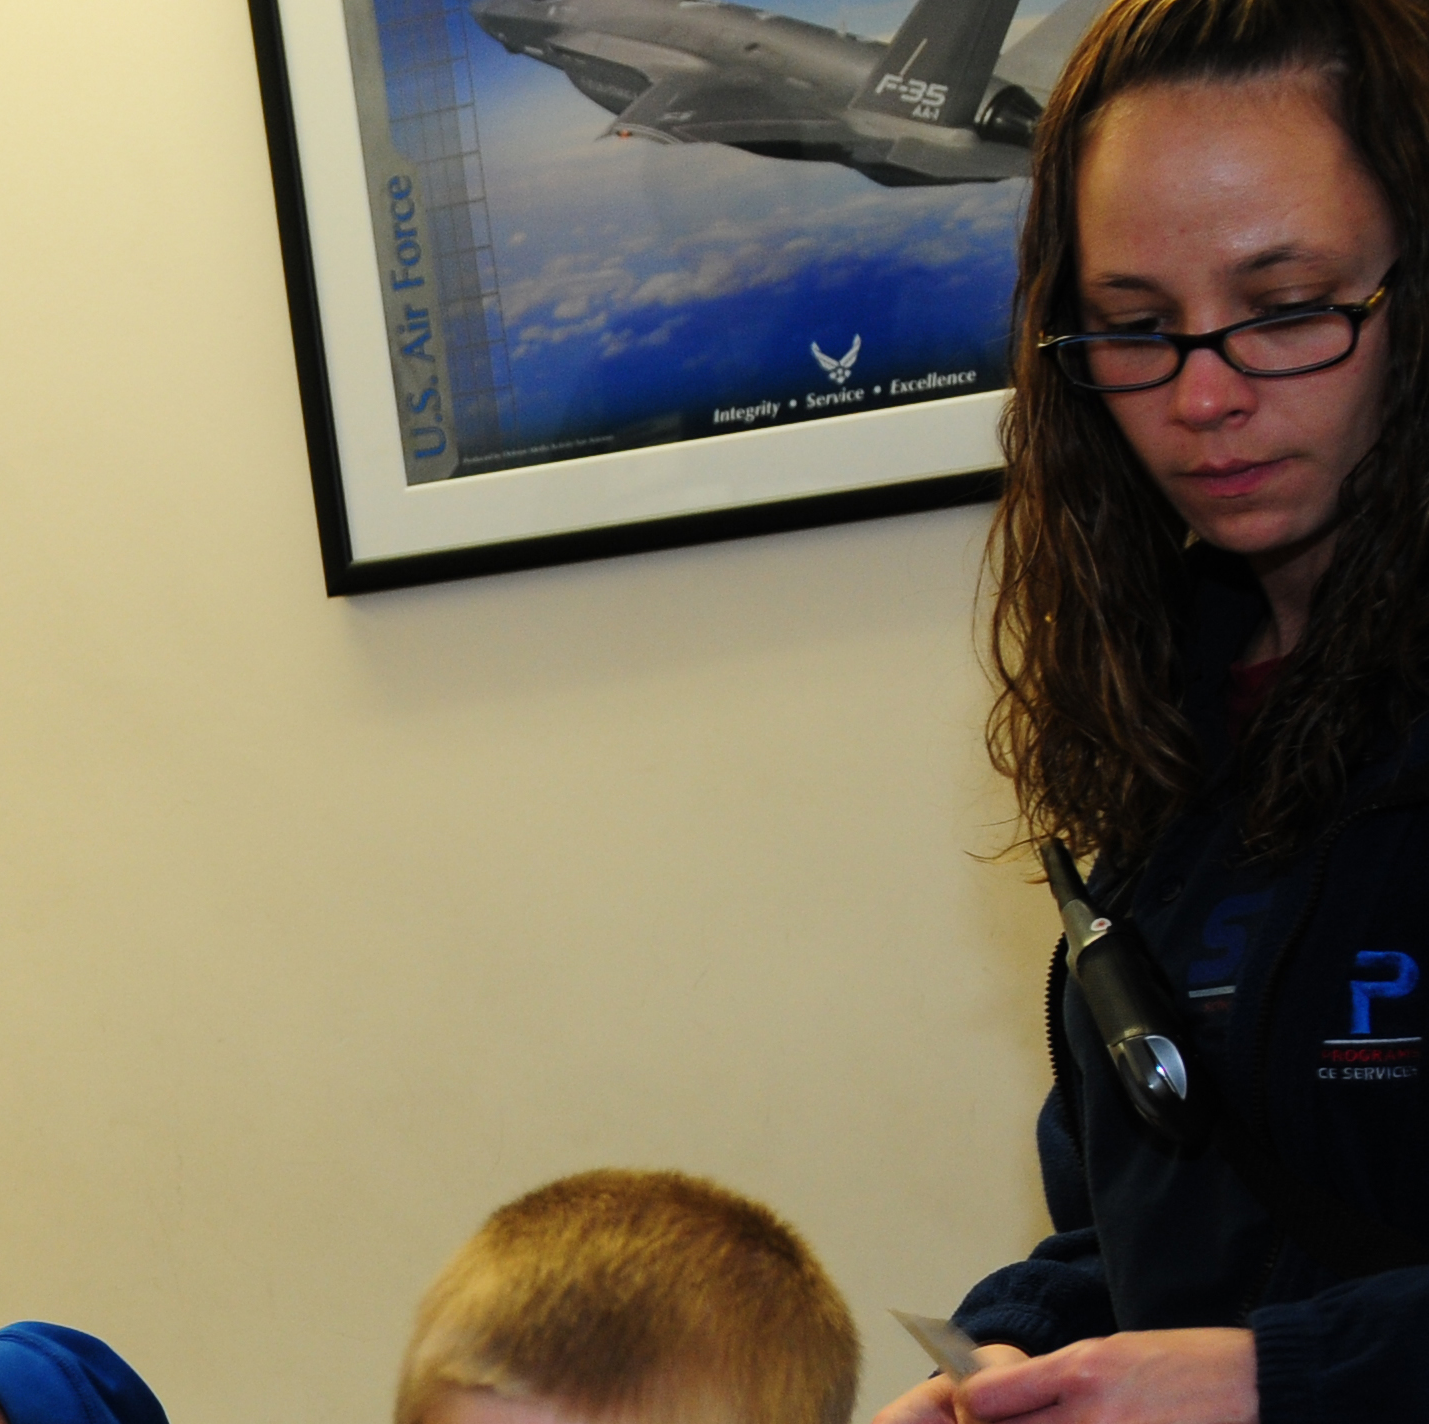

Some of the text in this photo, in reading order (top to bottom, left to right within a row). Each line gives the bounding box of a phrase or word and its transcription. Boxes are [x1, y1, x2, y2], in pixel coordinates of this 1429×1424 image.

[875, 73, 948, 107] F-35
[387, 175, 448, 459] U.S. Air Force
[712, 369, 978, 425] Integrity Service Excellence
